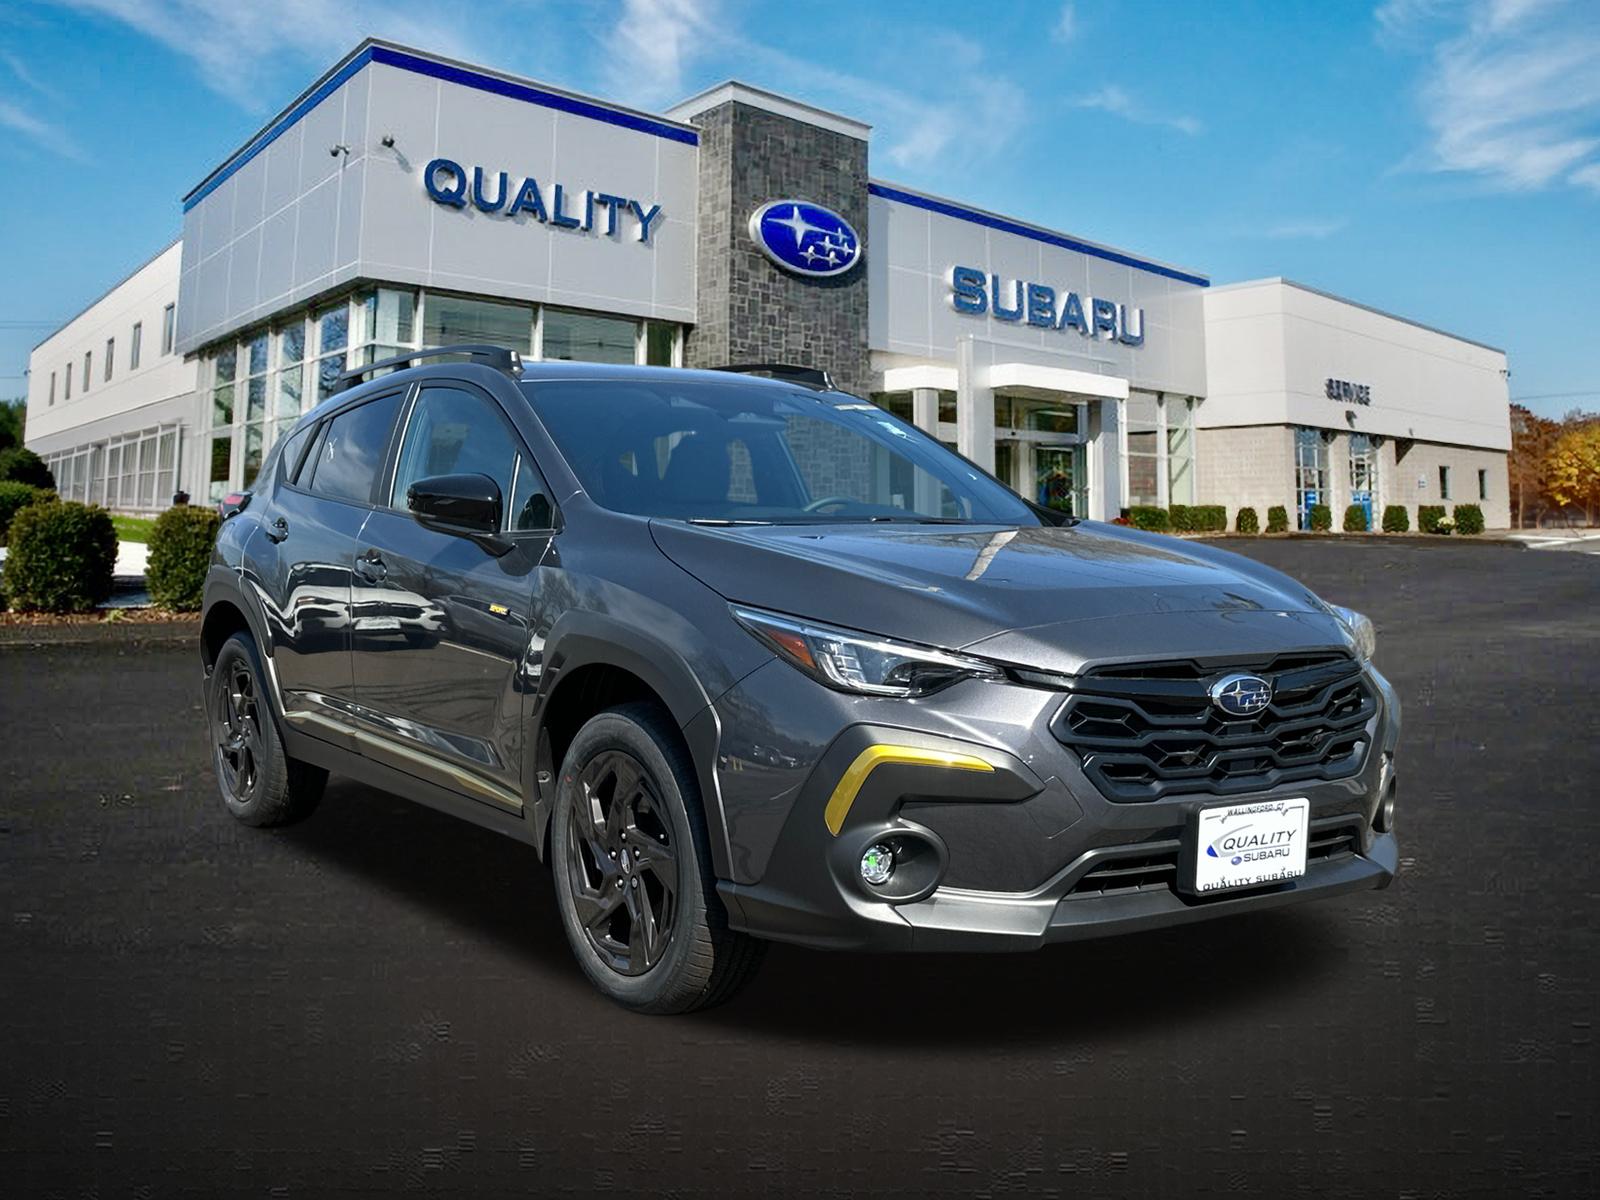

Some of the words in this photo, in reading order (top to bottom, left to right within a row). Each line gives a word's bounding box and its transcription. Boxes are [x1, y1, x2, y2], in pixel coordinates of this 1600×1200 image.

[423, 158, 661, 243] QUALITY
[950, 265, 1144, 347] SUBARU
[1325, 378, 1370, 406] SERVICE
[1223, 829, 1297, 851] QUALITY
[1243, 848, 1290, 863] SUBARU
[1203, 877, 1252, 892] QUALITY
[1255, 869, 1302, 883] SUBARU
